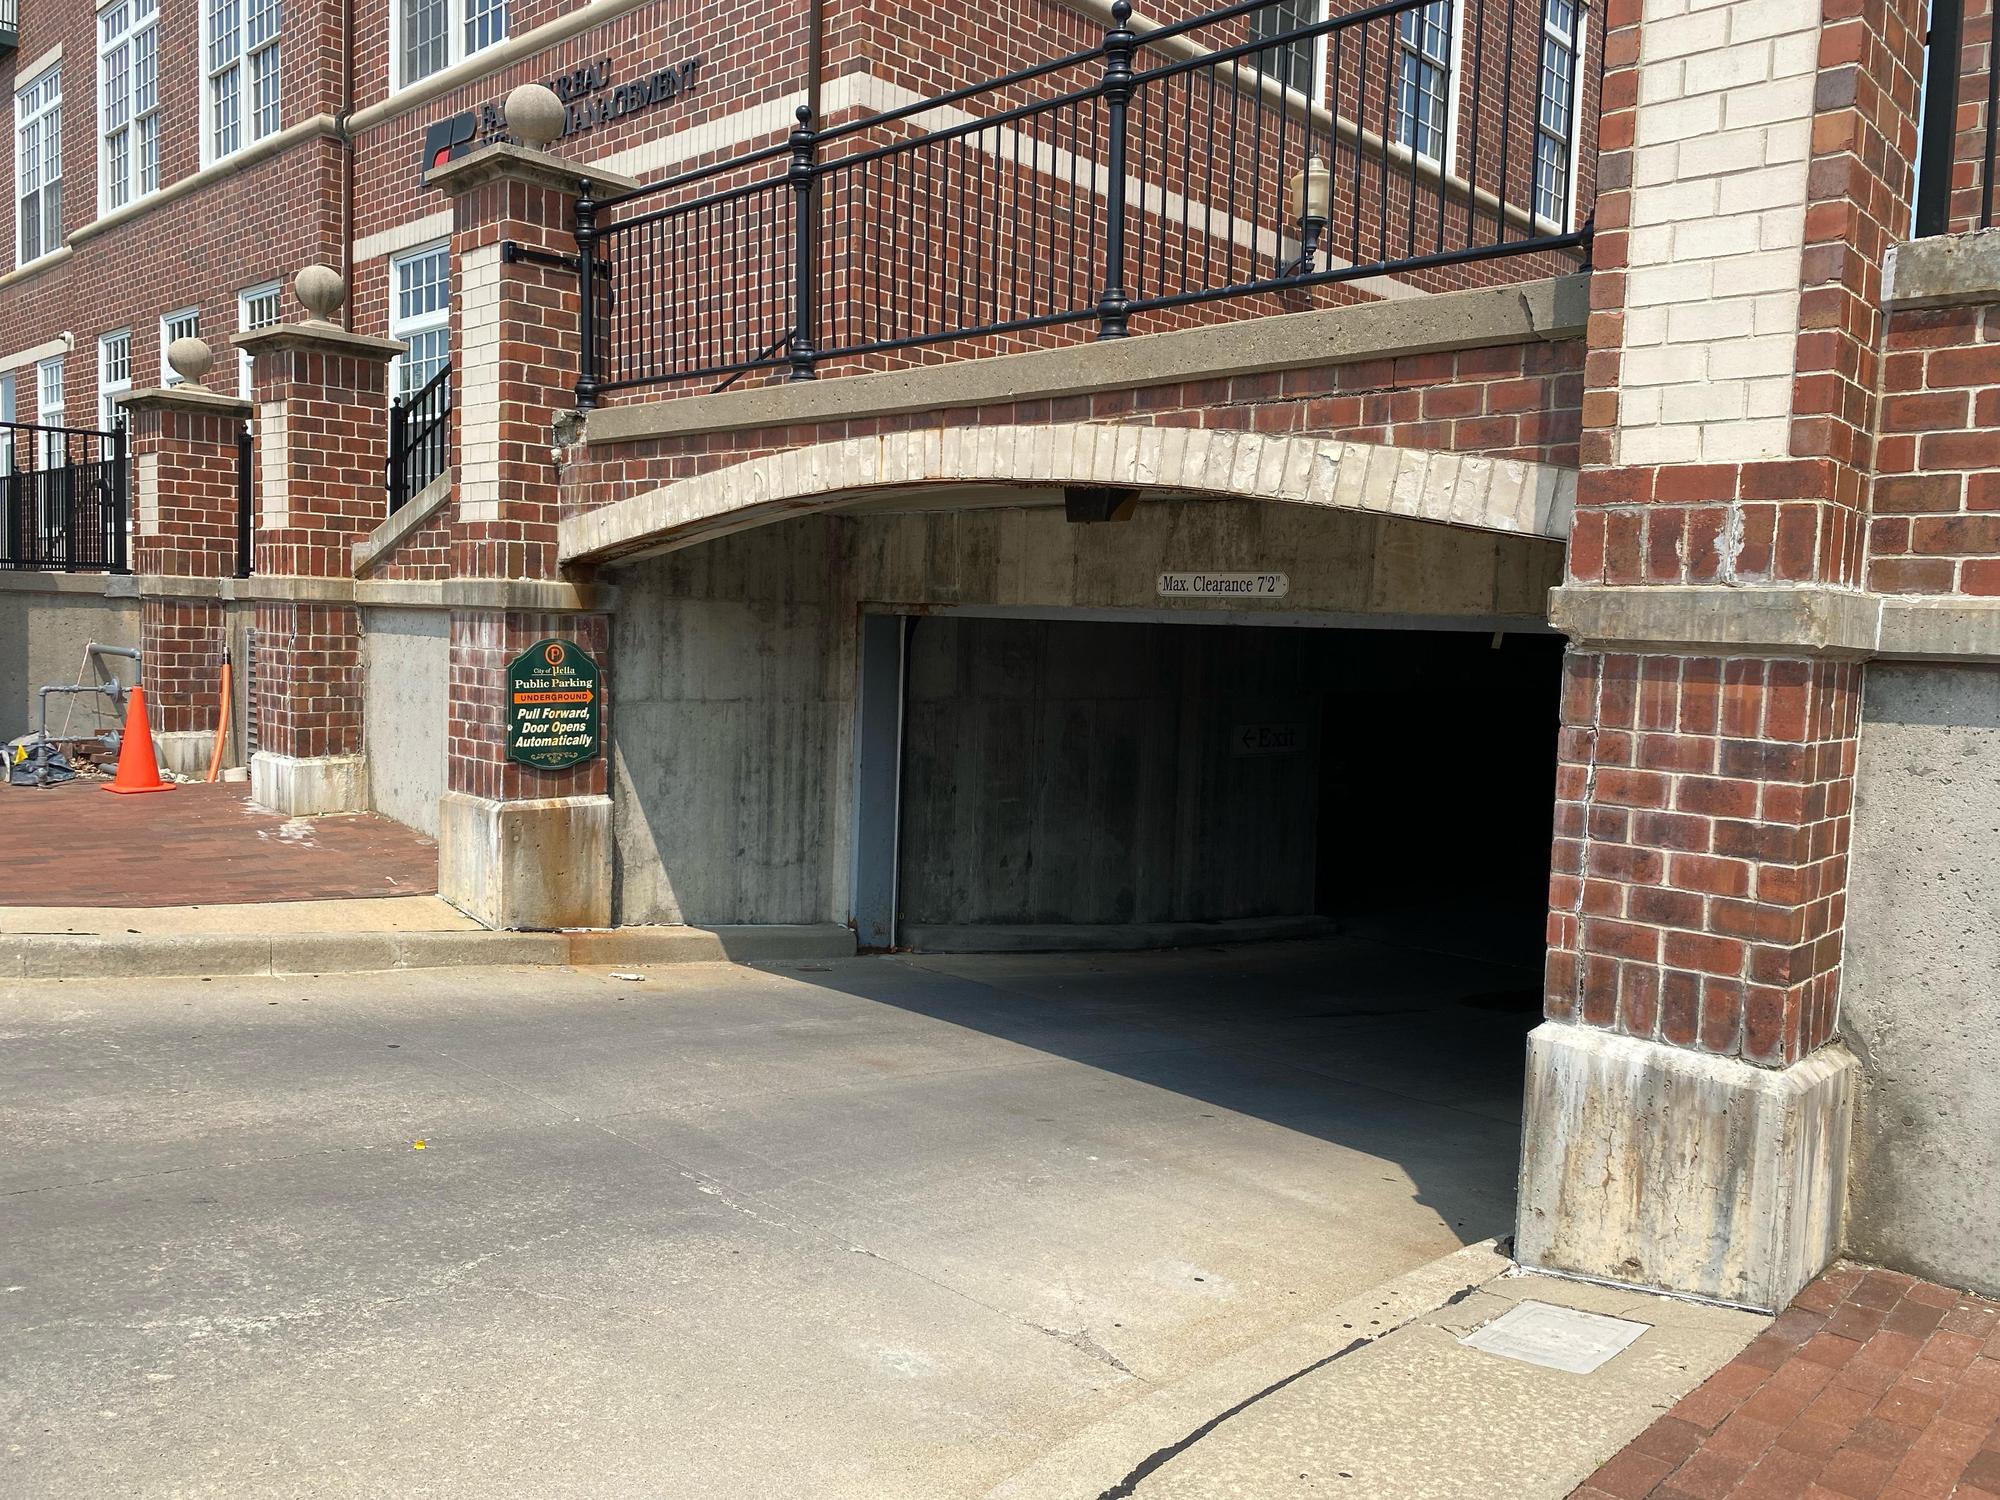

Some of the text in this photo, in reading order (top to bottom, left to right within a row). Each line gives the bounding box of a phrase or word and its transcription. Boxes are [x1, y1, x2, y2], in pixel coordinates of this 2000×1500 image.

[543, 58, 612, 103] REAU
[1163, 575, 1189, 592] Max.
[1193, 575, 1253, 592] Clearance
[533, 667, 544, 675] City
[552, 666, 576, 676] Pella
[515, 678, 593, 689] Public Parking
[520, 693, 588, 702] UNDERGROUND
[517, 707, 590, 720] Pull Forward,
[521, 721, 586, 734] Door Opens
[515, 734, 592, 748] Automatically
[1257, 727, 1295, 747] Exit
